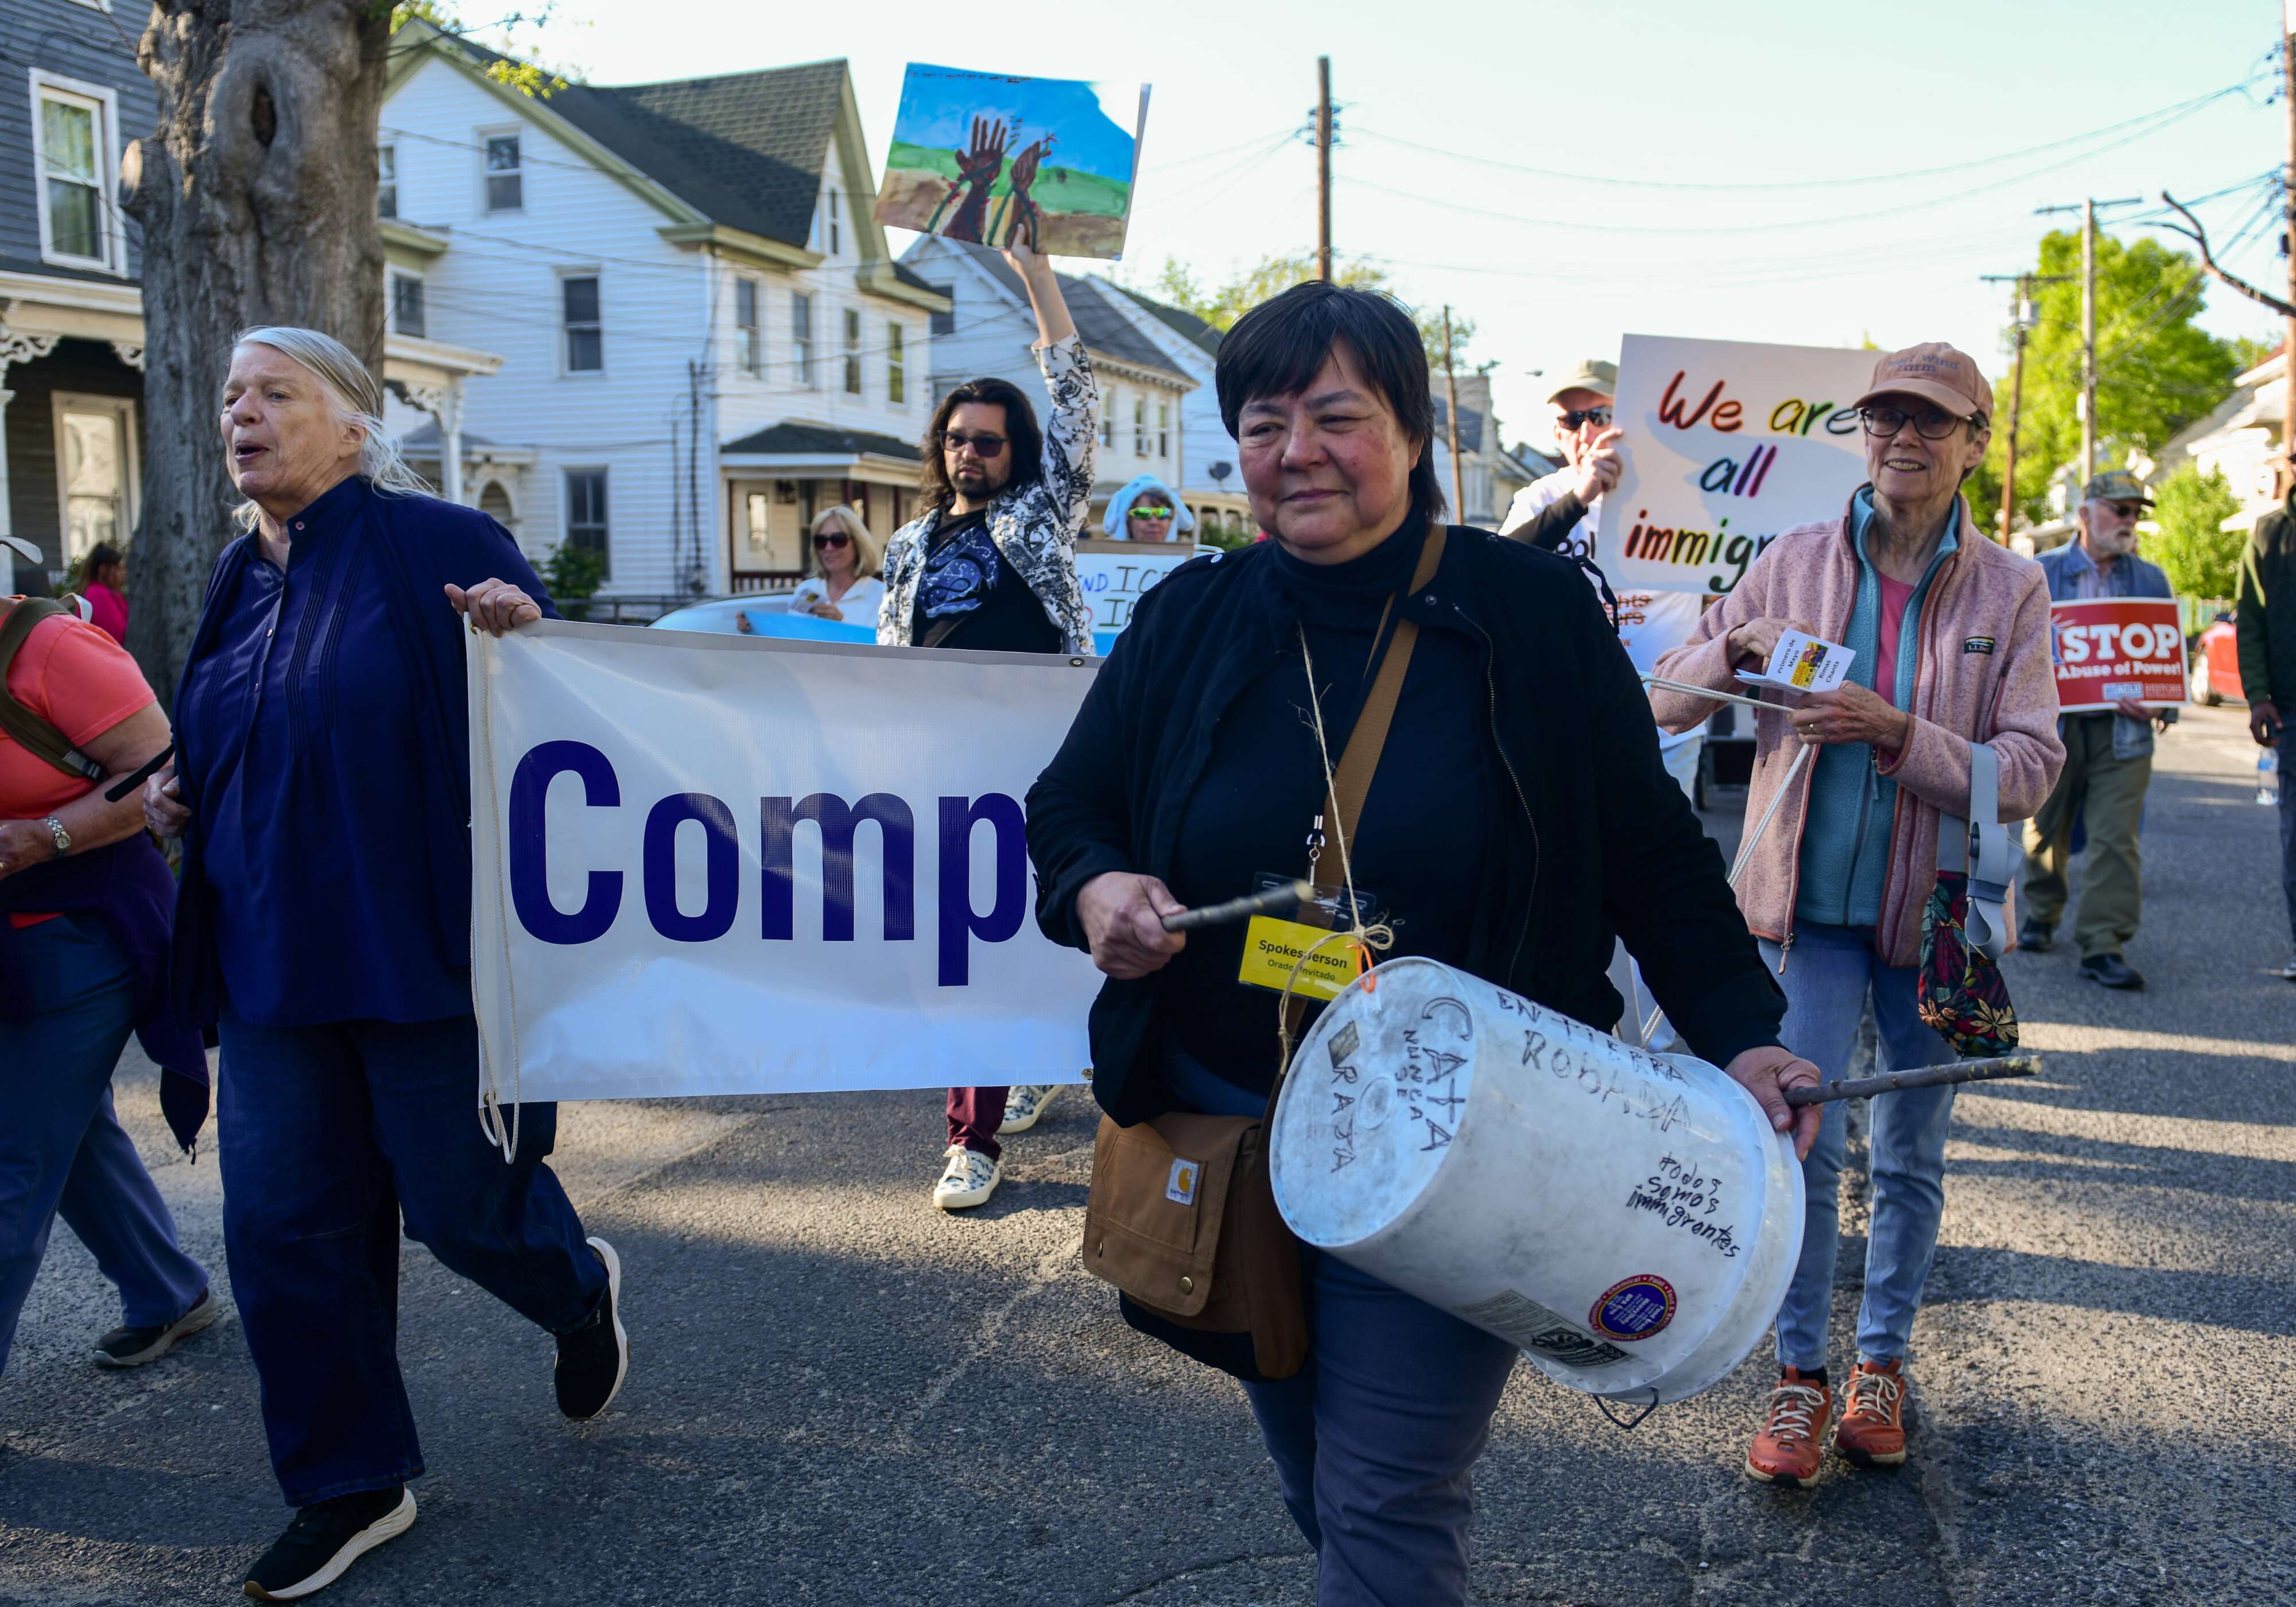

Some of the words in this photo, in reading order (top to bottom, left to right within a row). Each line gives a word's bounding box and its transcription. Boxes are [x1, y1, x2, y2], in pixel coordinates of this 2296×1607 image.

[1658, 370, 1743, 433] We
[1768, 397, 1858, 436] are
[1700, 444, 1777, 498] all
[1777, 648, 1791, 674] Primero
[1789, 639, 1796, 647] de
[2062, 623, 2179, 662] STOP
[1788, 650, 1799, 667] Mayo
[1818, 660, 1831, 679] Rimas
[1826, 661, 1840, 683] Chants
[2057, 664, 2112, 680] Abuse
[2114, 661, 2131, 676] of
[2132, 661, 2181, 676] Power!
[509, 740, 1028, 987] Comp
[1258, 940, 1347, 969] Spokeserson
[1267, 959, 1296, 972] Orado
[1496, 991, 1541, 1023] EN
[1420, 996, 1473, 1151] CATA
[1607, 1276, 1641, 1295] Chemical
